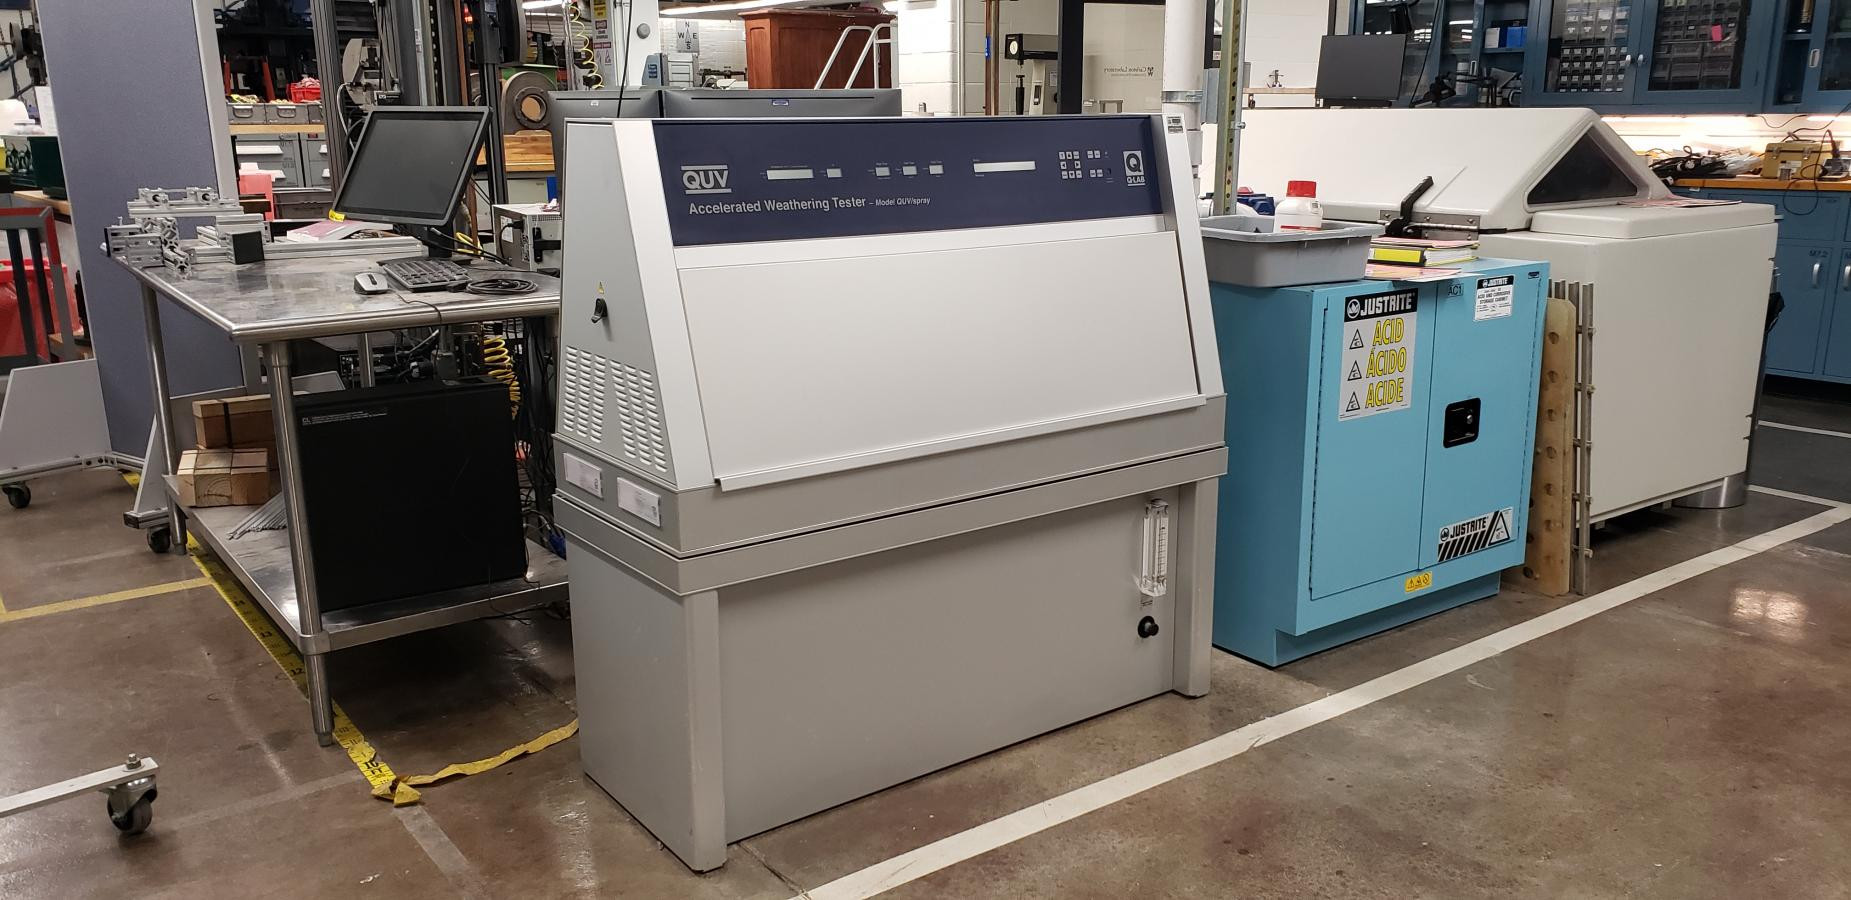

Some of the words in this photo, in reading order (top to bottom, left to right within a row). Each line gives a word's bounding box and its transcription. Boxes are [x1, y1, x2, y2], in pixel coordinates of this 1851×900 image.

[692, 32, 698, 40] E
[682, 170, 729, 190] QUV
[689, 200, 762, 215] Accelerated
[764, 198, 830, 212] Weathering
[832, 196, 866, 209] Tester
[875, 198, 896, 206] Model
[896, 196, 931, 207] QUV/spray
[1360, 294, 1412, 317] JUSTRITE
[1373, 317, 1405, 346] ACID
[1366, 346, 1407, 378] ÁCIDO
[1365, 377, 1405, 408] ACIDE
[1450, 516, 1487, 538] JUSTRITE
